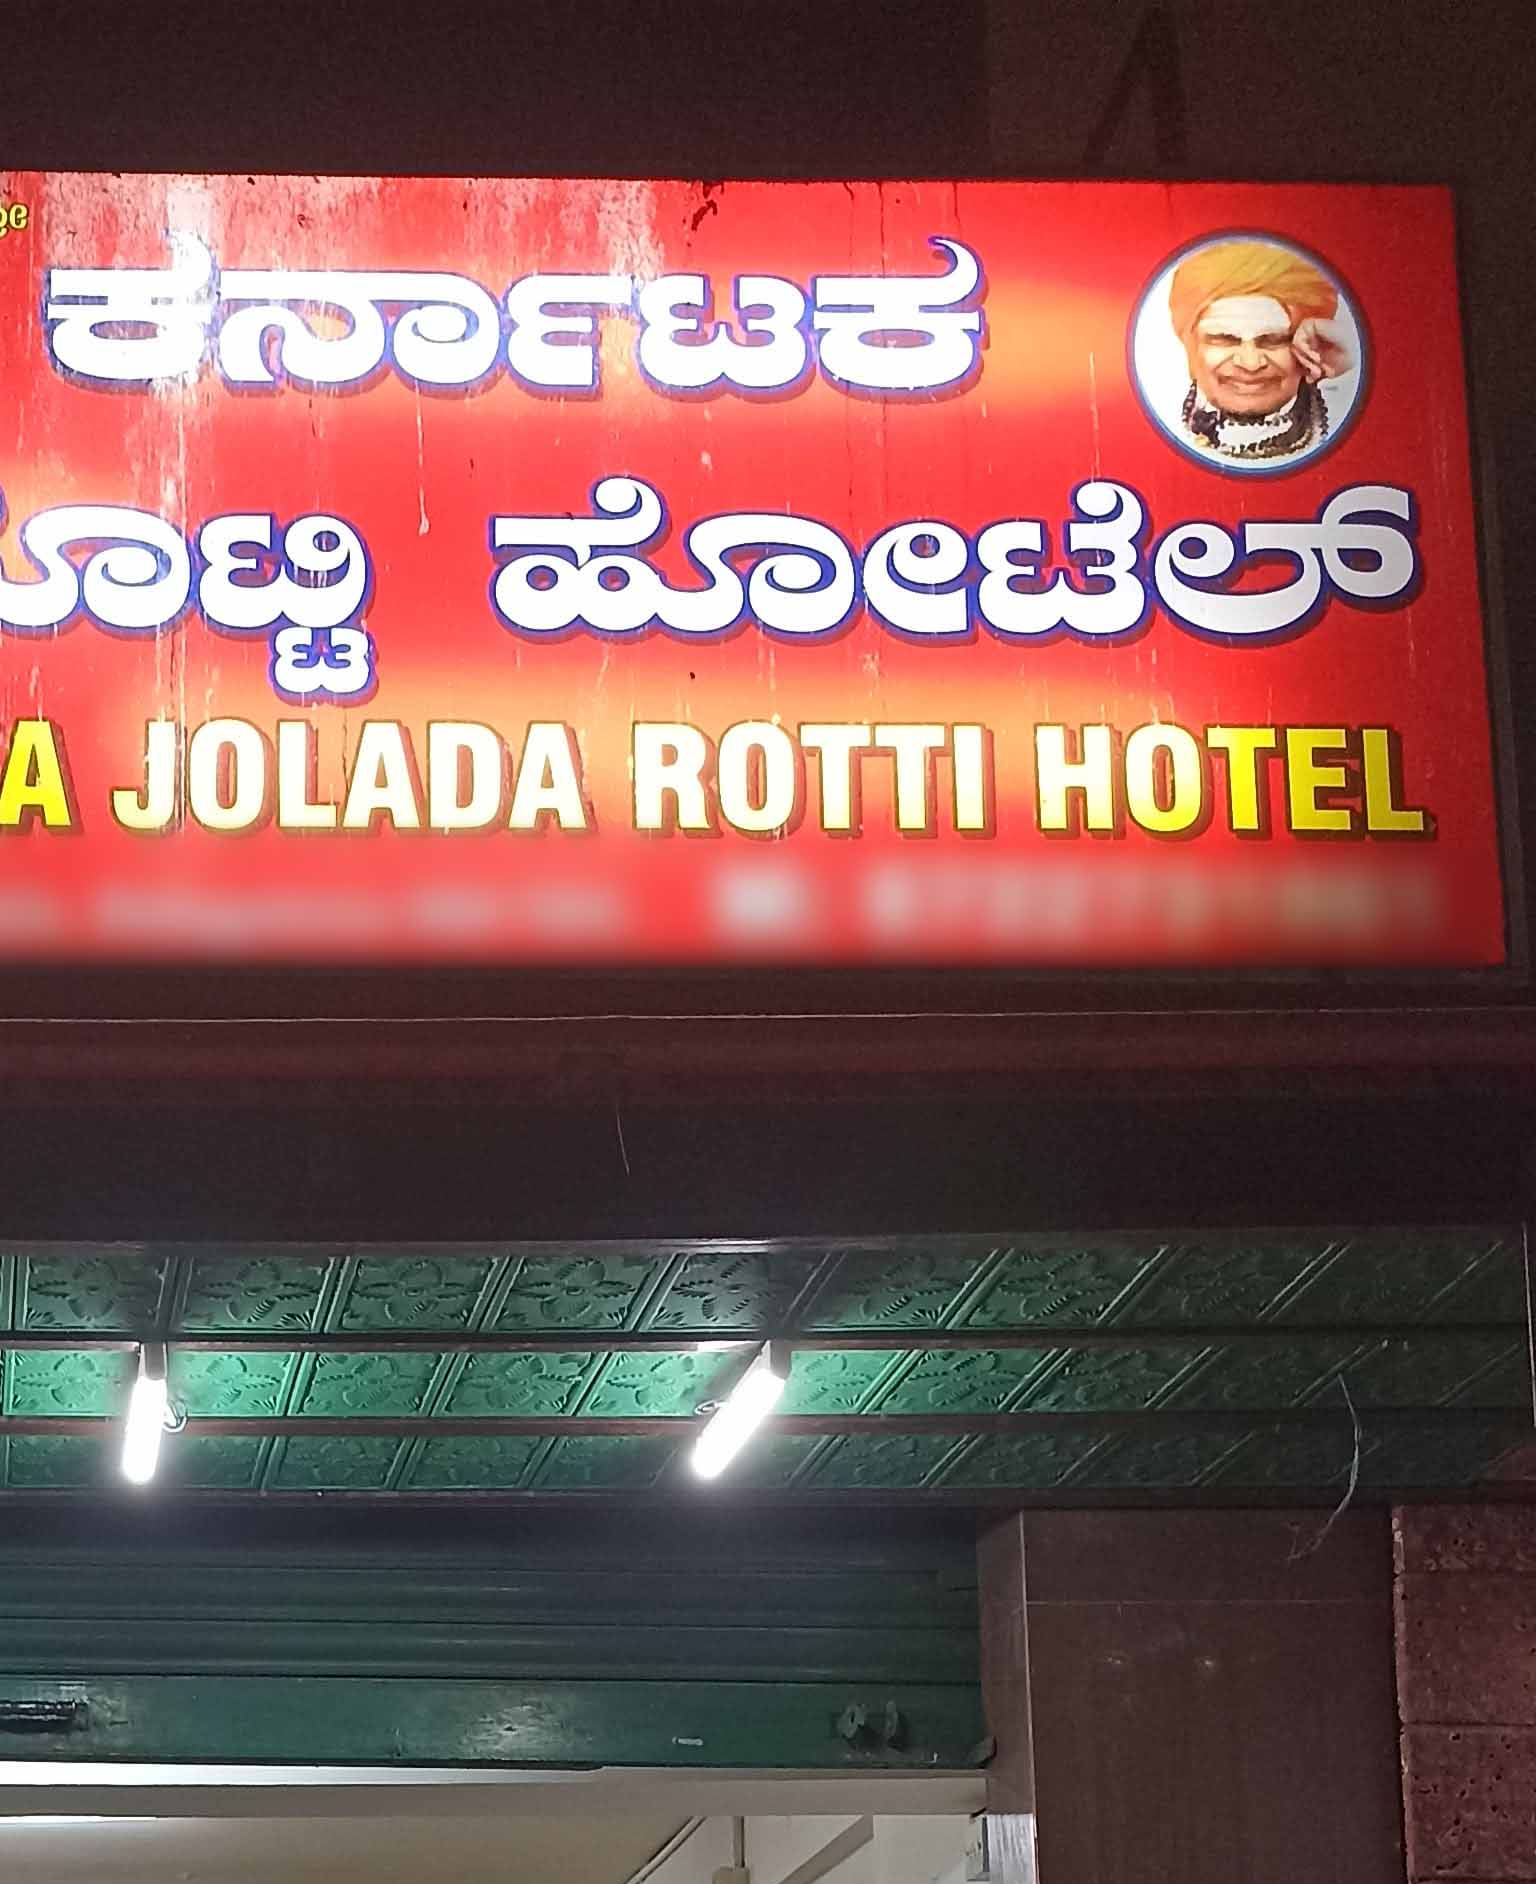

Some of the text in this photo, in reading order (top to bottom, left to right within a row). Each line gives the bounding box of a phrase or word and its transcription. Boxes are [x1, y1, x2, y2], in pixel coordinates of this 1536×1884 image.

[44, 234, 985, 393] ಕರ್ನಾಟಕ
[491, 476, 1417, 641] ಹೋಟೆಲ್
[112, 718, 590, 832] JOLADA
[630, 719, 987, 835] ROTTI
[1033, 721, 1430, 836] HOTEL
